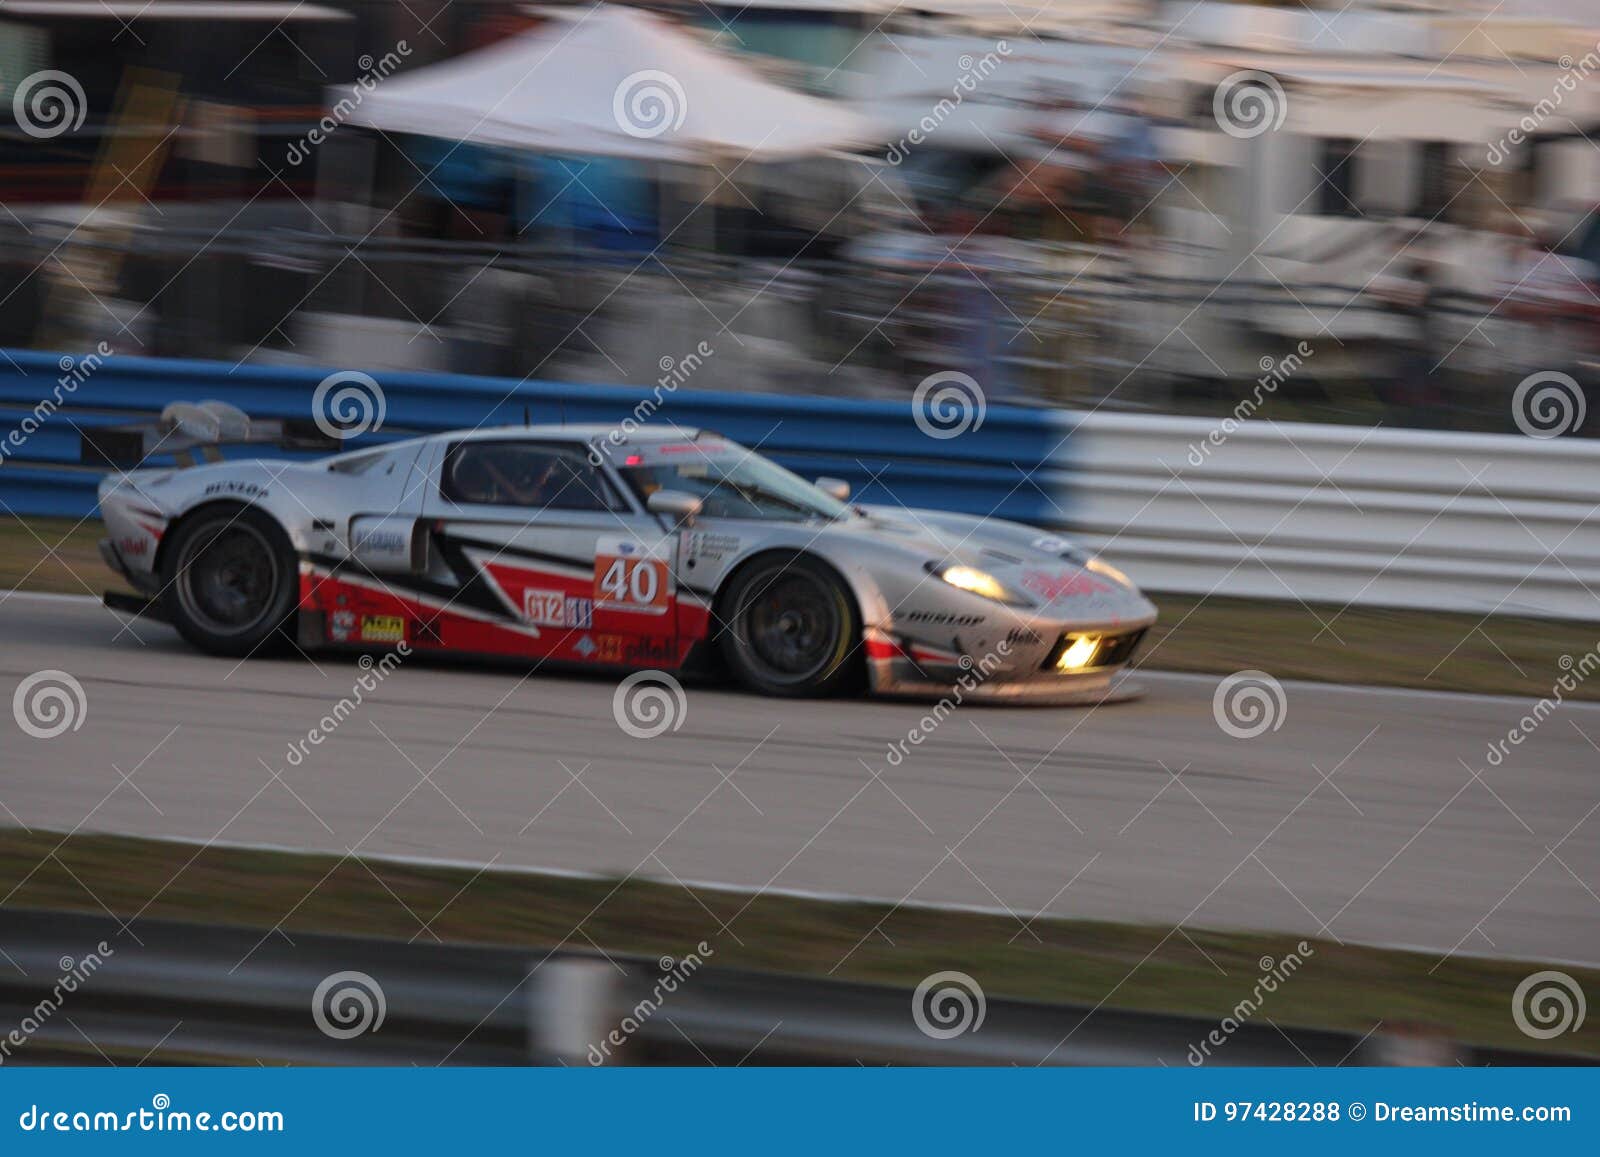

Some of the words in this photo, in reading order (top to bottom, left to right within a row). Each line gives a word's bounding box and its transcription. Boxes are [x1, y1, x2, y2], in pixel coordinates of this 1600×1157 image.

[601, 558, 659, 606] 40
[528, 593, 563, 621] GT2
[908, 611, 986, 627] DUNLOP
